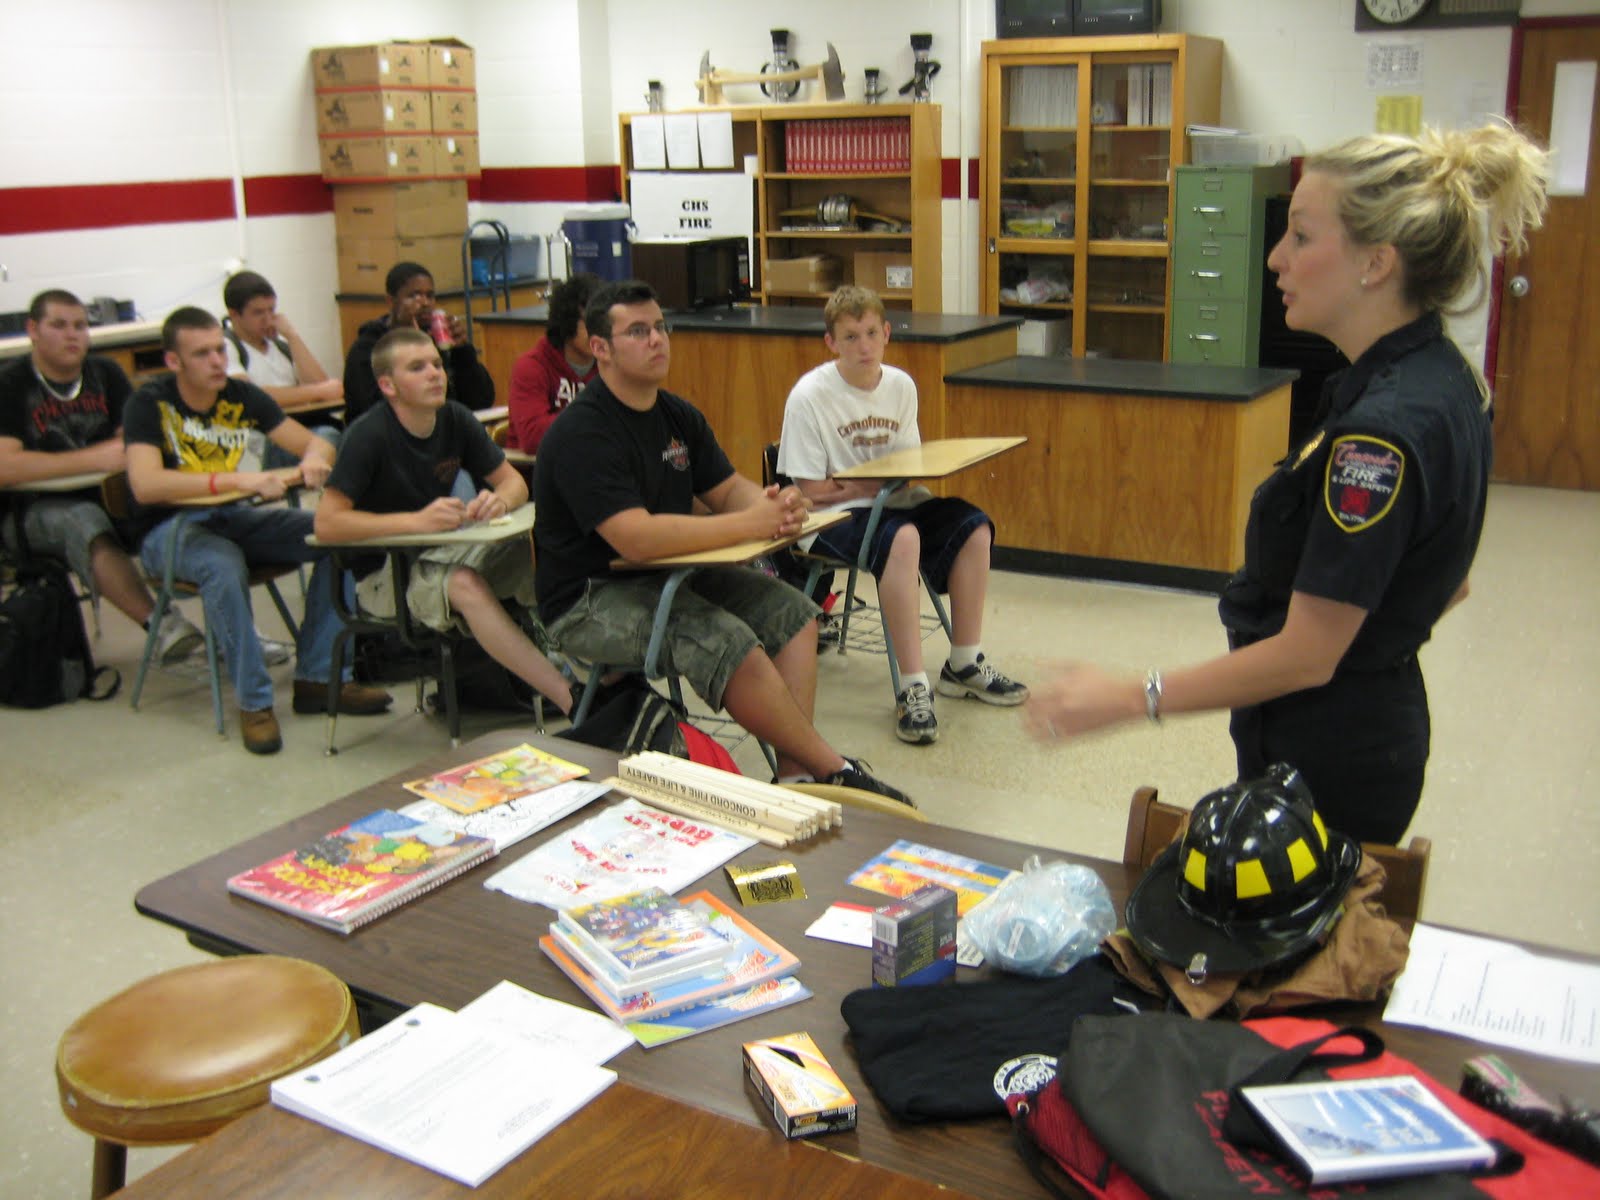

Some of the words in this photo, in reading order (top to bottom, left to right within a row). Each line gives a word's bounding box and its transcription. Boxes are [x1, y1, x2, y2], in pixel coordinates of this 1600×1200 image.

[682, 200, 708, 211] CHS
[680, 218, 712, 228] FIRE
[1344, 466, 1381, 483] FIRE
[1360, 481, 1392, 494] SAFETY
[626, 767, 658, 785] SAFETY
[660, 777, 678, 791] LIFE
[680, 784, 687, 794] &
[688, 787, 708, 802] FIRE
[710, 795, 756, 818] CONCORD
